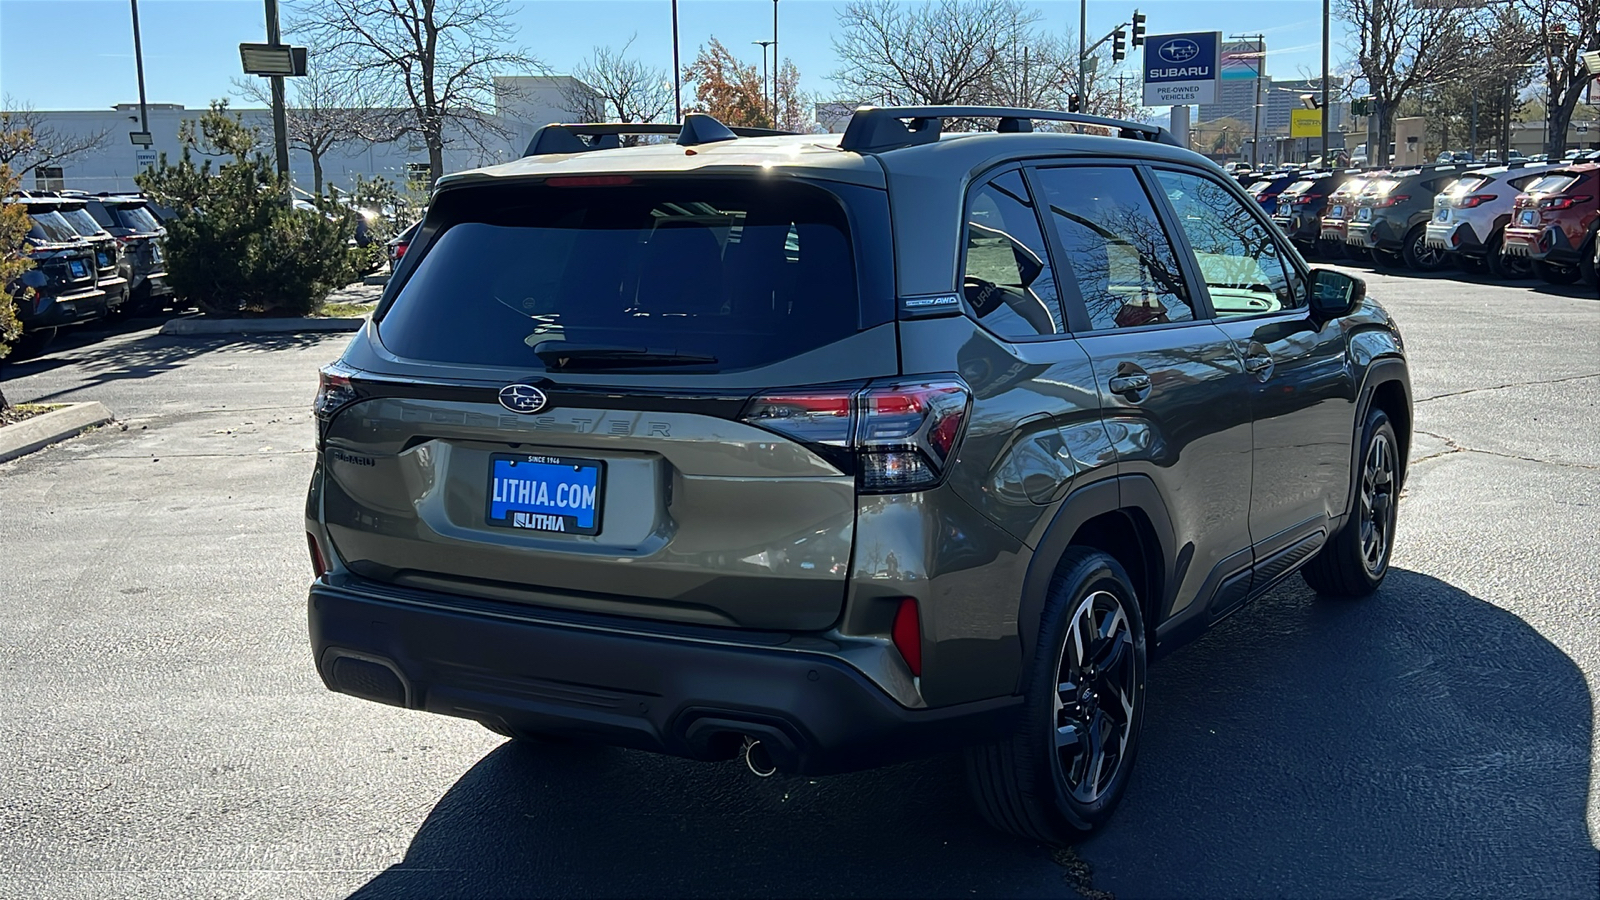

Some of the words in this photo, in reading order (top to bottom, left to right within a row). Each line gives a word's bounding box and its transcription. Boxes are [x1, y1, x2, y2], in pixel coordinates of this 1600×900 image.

[1150, 66, 1208, 78] SUBARU
[1157, 86, 1199, 94] PRE-OWNED
[1161, 93, 1195, 101] VEHICLES
[934, 297, 957, 305] AWD
[400, 406, 671, 437] FORESTER
[334, 451, 376, 467] SUBARU
[528, 455, 545, 463] SINCE
[547, 456, 560, 465] 1946
[492, 477, 596, 510] LITHIA.COM
[525, 513, 565, 532] LITHIA
